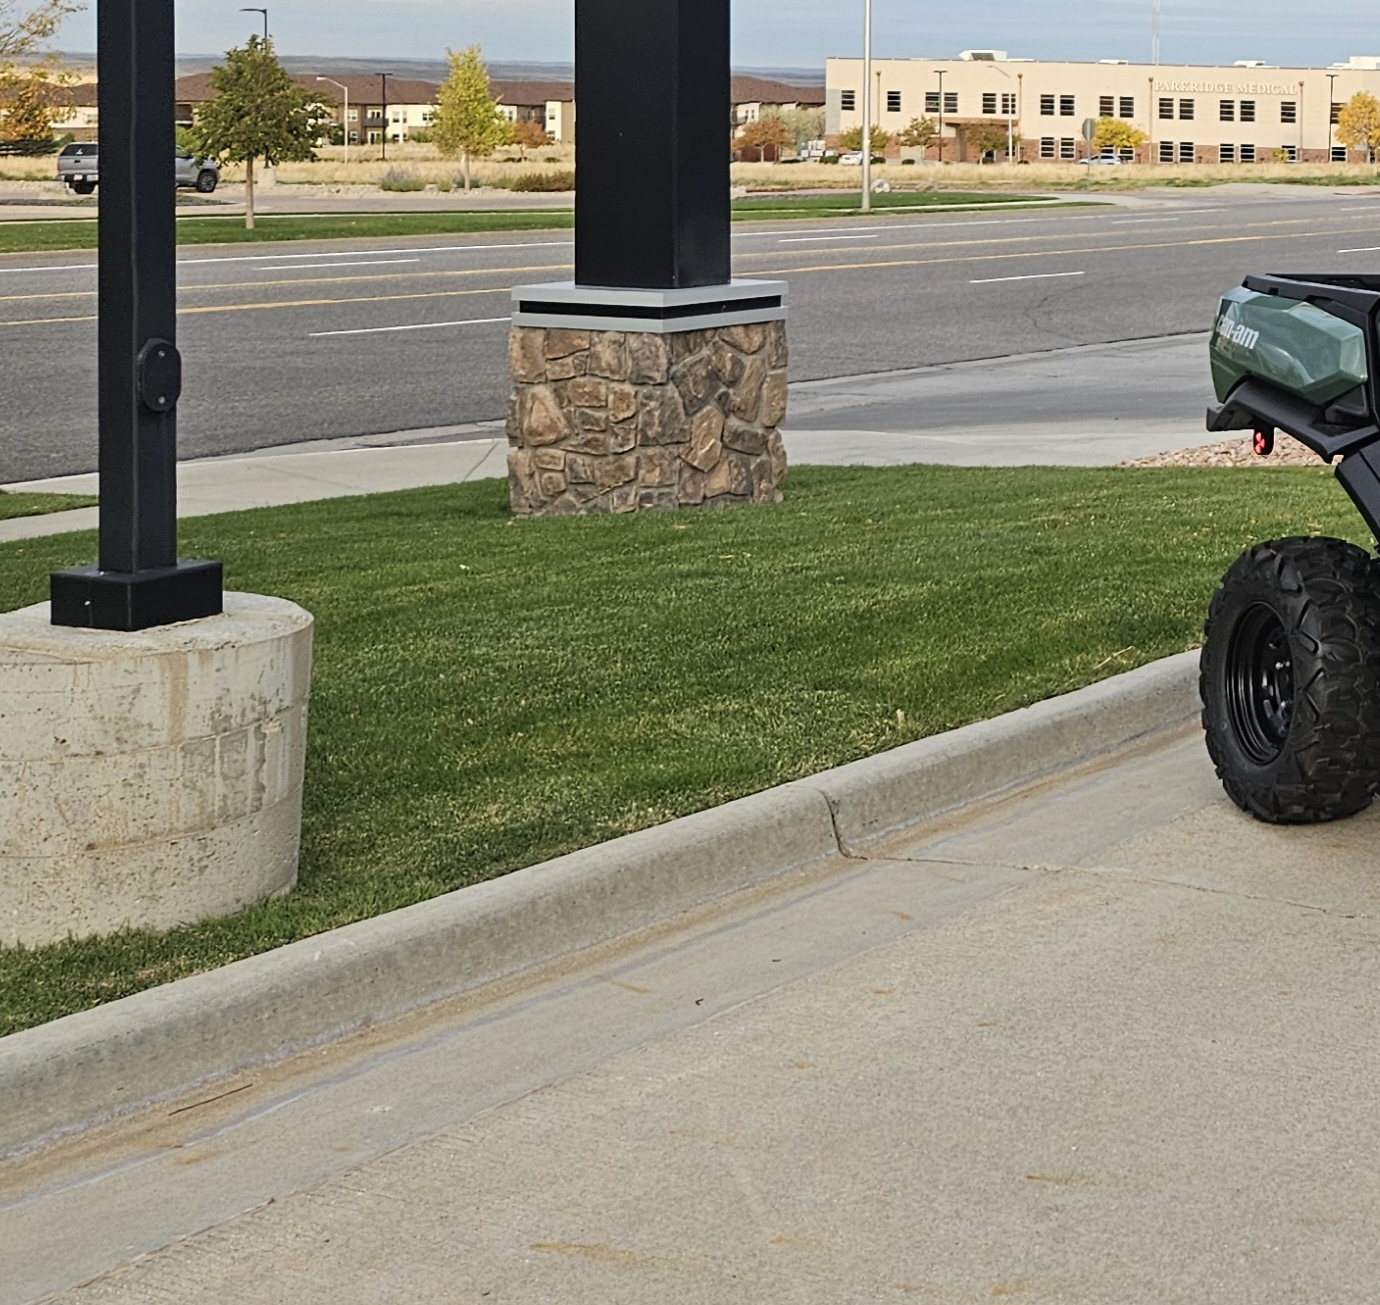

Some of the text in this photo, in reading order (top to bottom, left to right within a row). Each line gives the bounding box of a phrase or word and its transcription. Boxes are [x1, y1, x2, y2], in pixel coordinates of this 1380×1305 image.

[1155, 81, 1298, 95] PARKRIDGE MEDICAL
[1216, 314, 1260, 350] can-am
